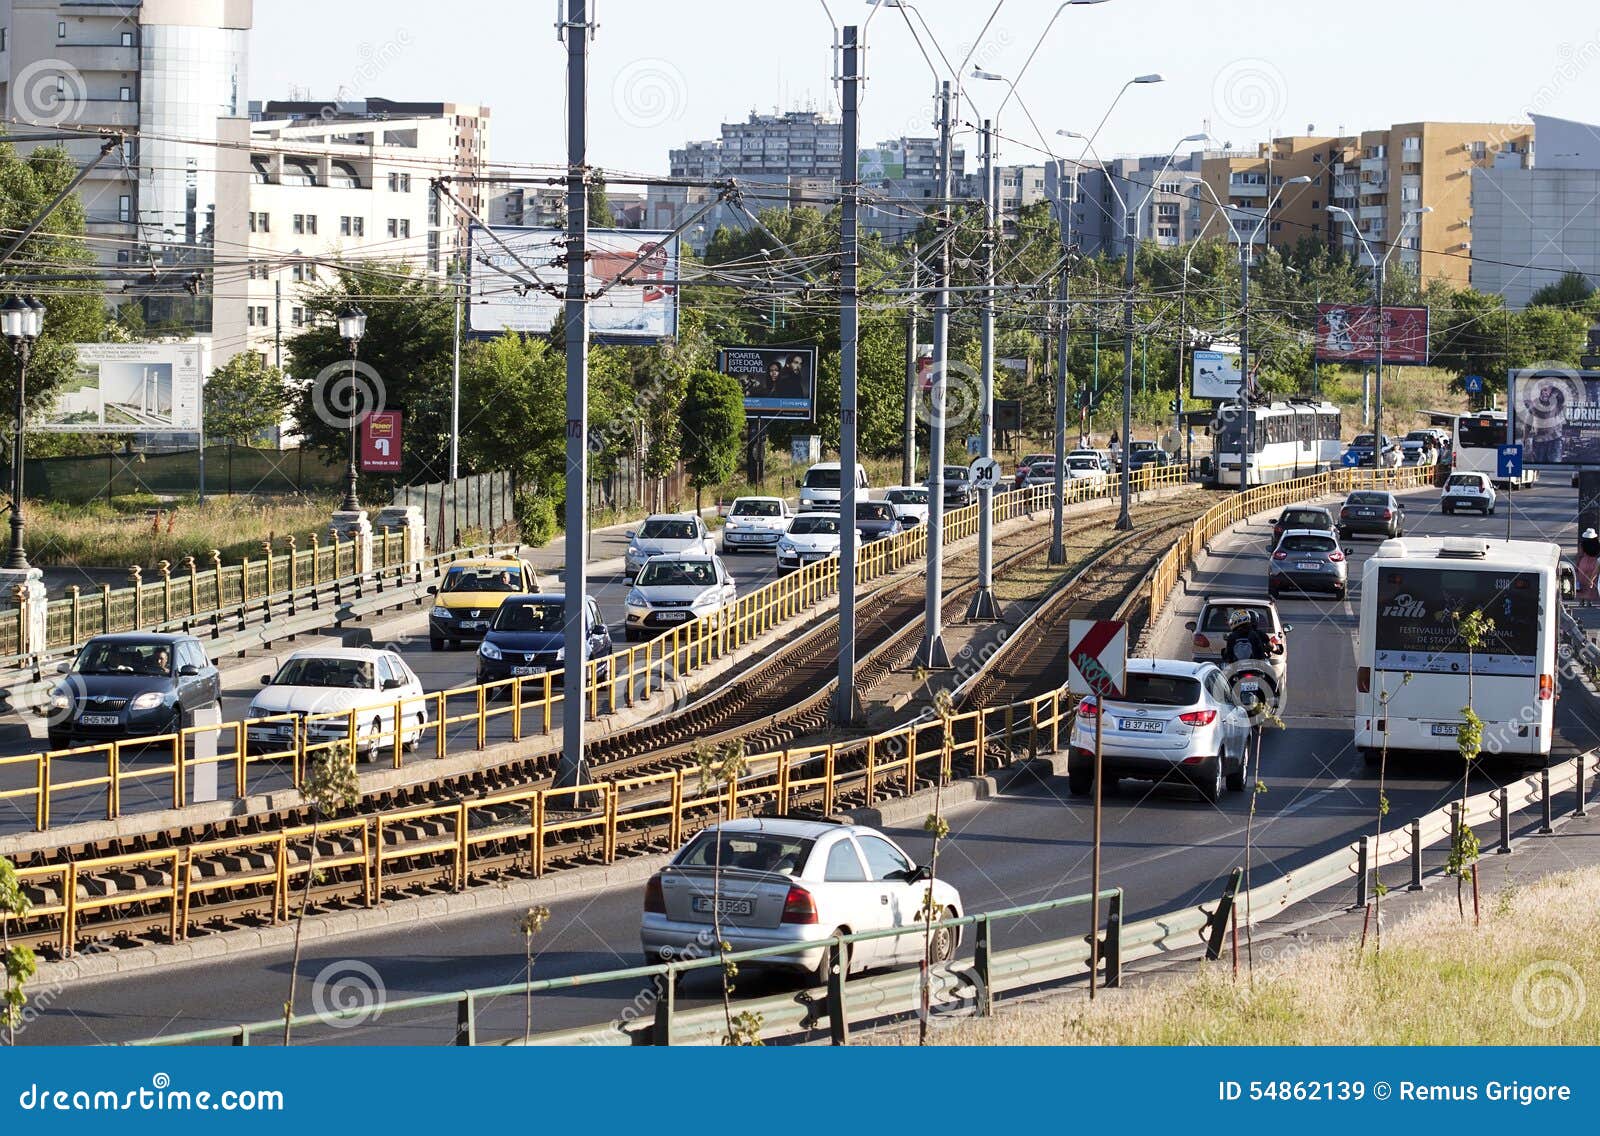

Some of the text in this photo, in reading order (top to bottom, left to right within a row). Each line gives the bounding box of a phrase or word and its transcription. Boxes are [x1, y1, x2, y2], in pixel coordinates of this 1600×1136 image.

[728, 352, 761, 360] MOARTEA
[743, 359, 763, 367] DOAR
[976, 466, 993, 480] 30
[1124, 720, 1161, 731] B 37 HKP
